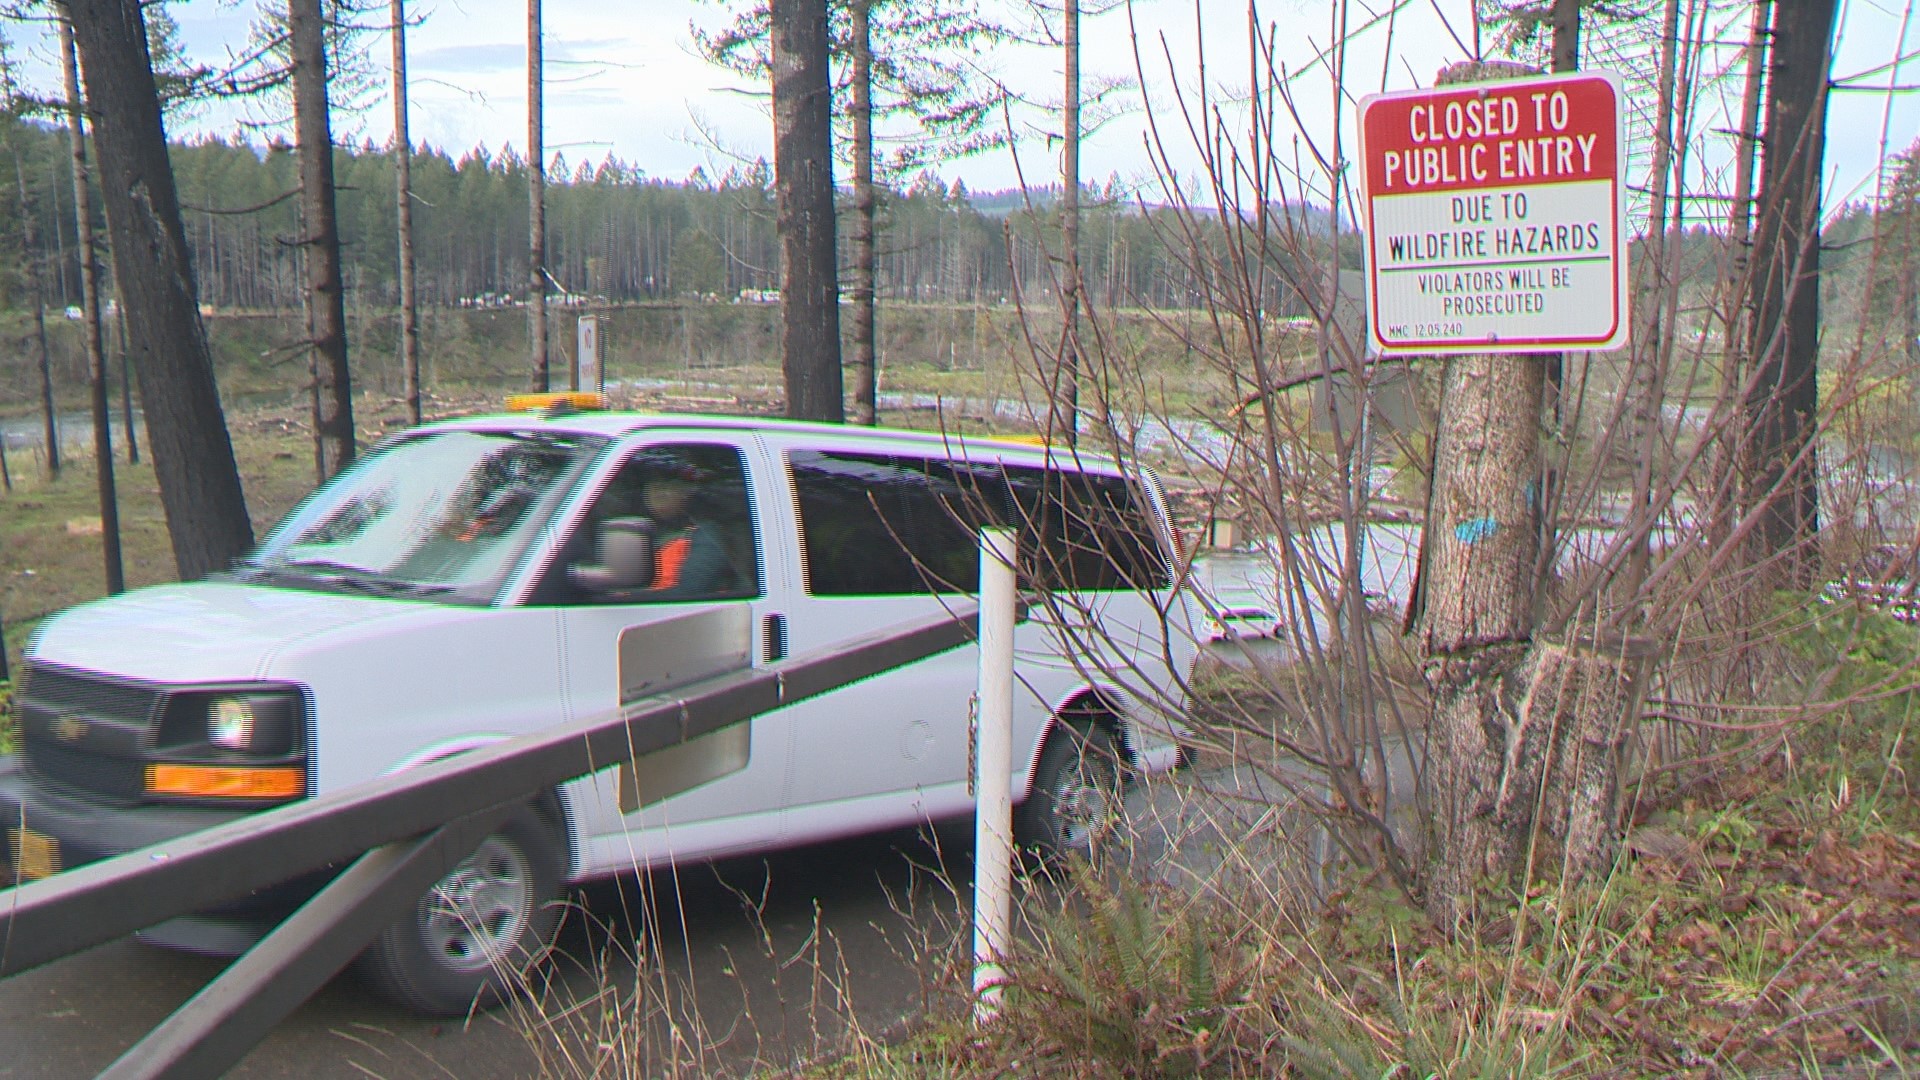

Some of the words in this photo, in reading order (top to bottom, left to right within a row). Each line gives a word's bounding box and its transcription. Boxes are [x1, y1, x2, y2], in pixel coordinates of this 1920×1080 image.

[1410, 96, 1519, 143] CLOSED
[1531, 90, 1569, 132] TO
[1384, 142, 1487, 187] PUBLIC
[1499, 133, 1597, 179] ENTRY
[1451, 196, 1492, 223] DUE
[1500, 192, 1527, 219] TO
[1388, 230, 1486, 261] WILDFIRE
[1495, 223, 1599, 254] HAZARDS
[1418, 271, 1503, 293] VIOLATORS
[1508, 268, 1546, 289] WILL
[1551, 267, 1570, 287] BE
[1443, 293, 1543, 316] PROSECUTED
[1388, 324, 1408, 337] MMC
